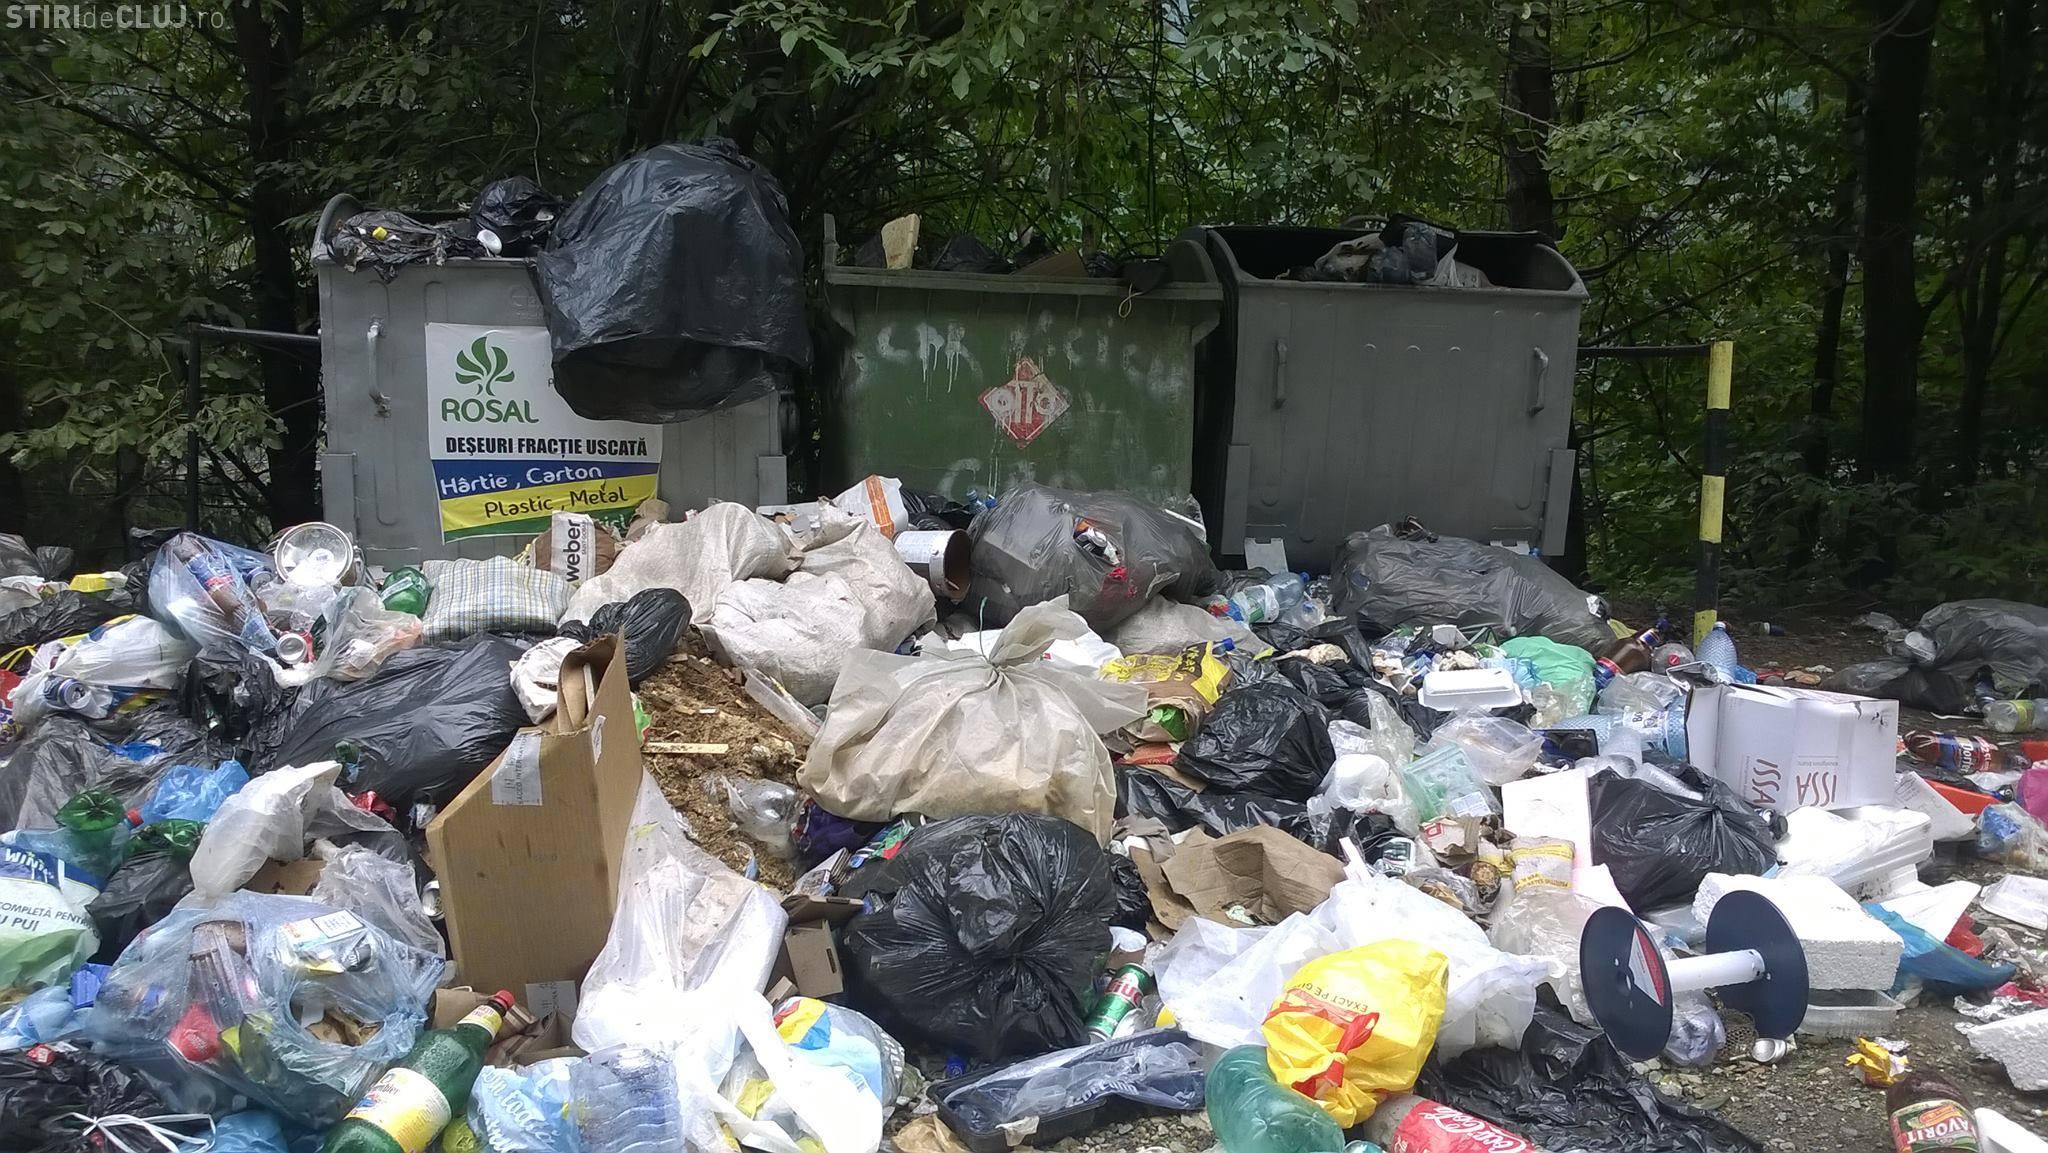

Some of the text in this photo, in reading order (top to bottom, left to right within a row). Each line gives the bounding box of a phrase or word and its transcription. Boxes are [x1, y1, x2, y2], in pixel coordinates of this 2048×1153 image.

[441, 397, 539, 425] ROSAL
[586, 437, 647, 457] USCATĂ
[441, 473, 508, 496] Hârtie
[526, 466, 602, 484] Carton
[484, 496, 553, 519] Plastic
[570, 486, 628, 507] Metal
[562, 519, 581, 582] weber
[1751, 758, 1782, 804] ISSA
[1796, 771, 1837, 807] ISSA
[11, 917, 40, 932] PUI
[1314, 985, 1330, 1000] PE
[1330, 994, 1369, 1013] EXACT
